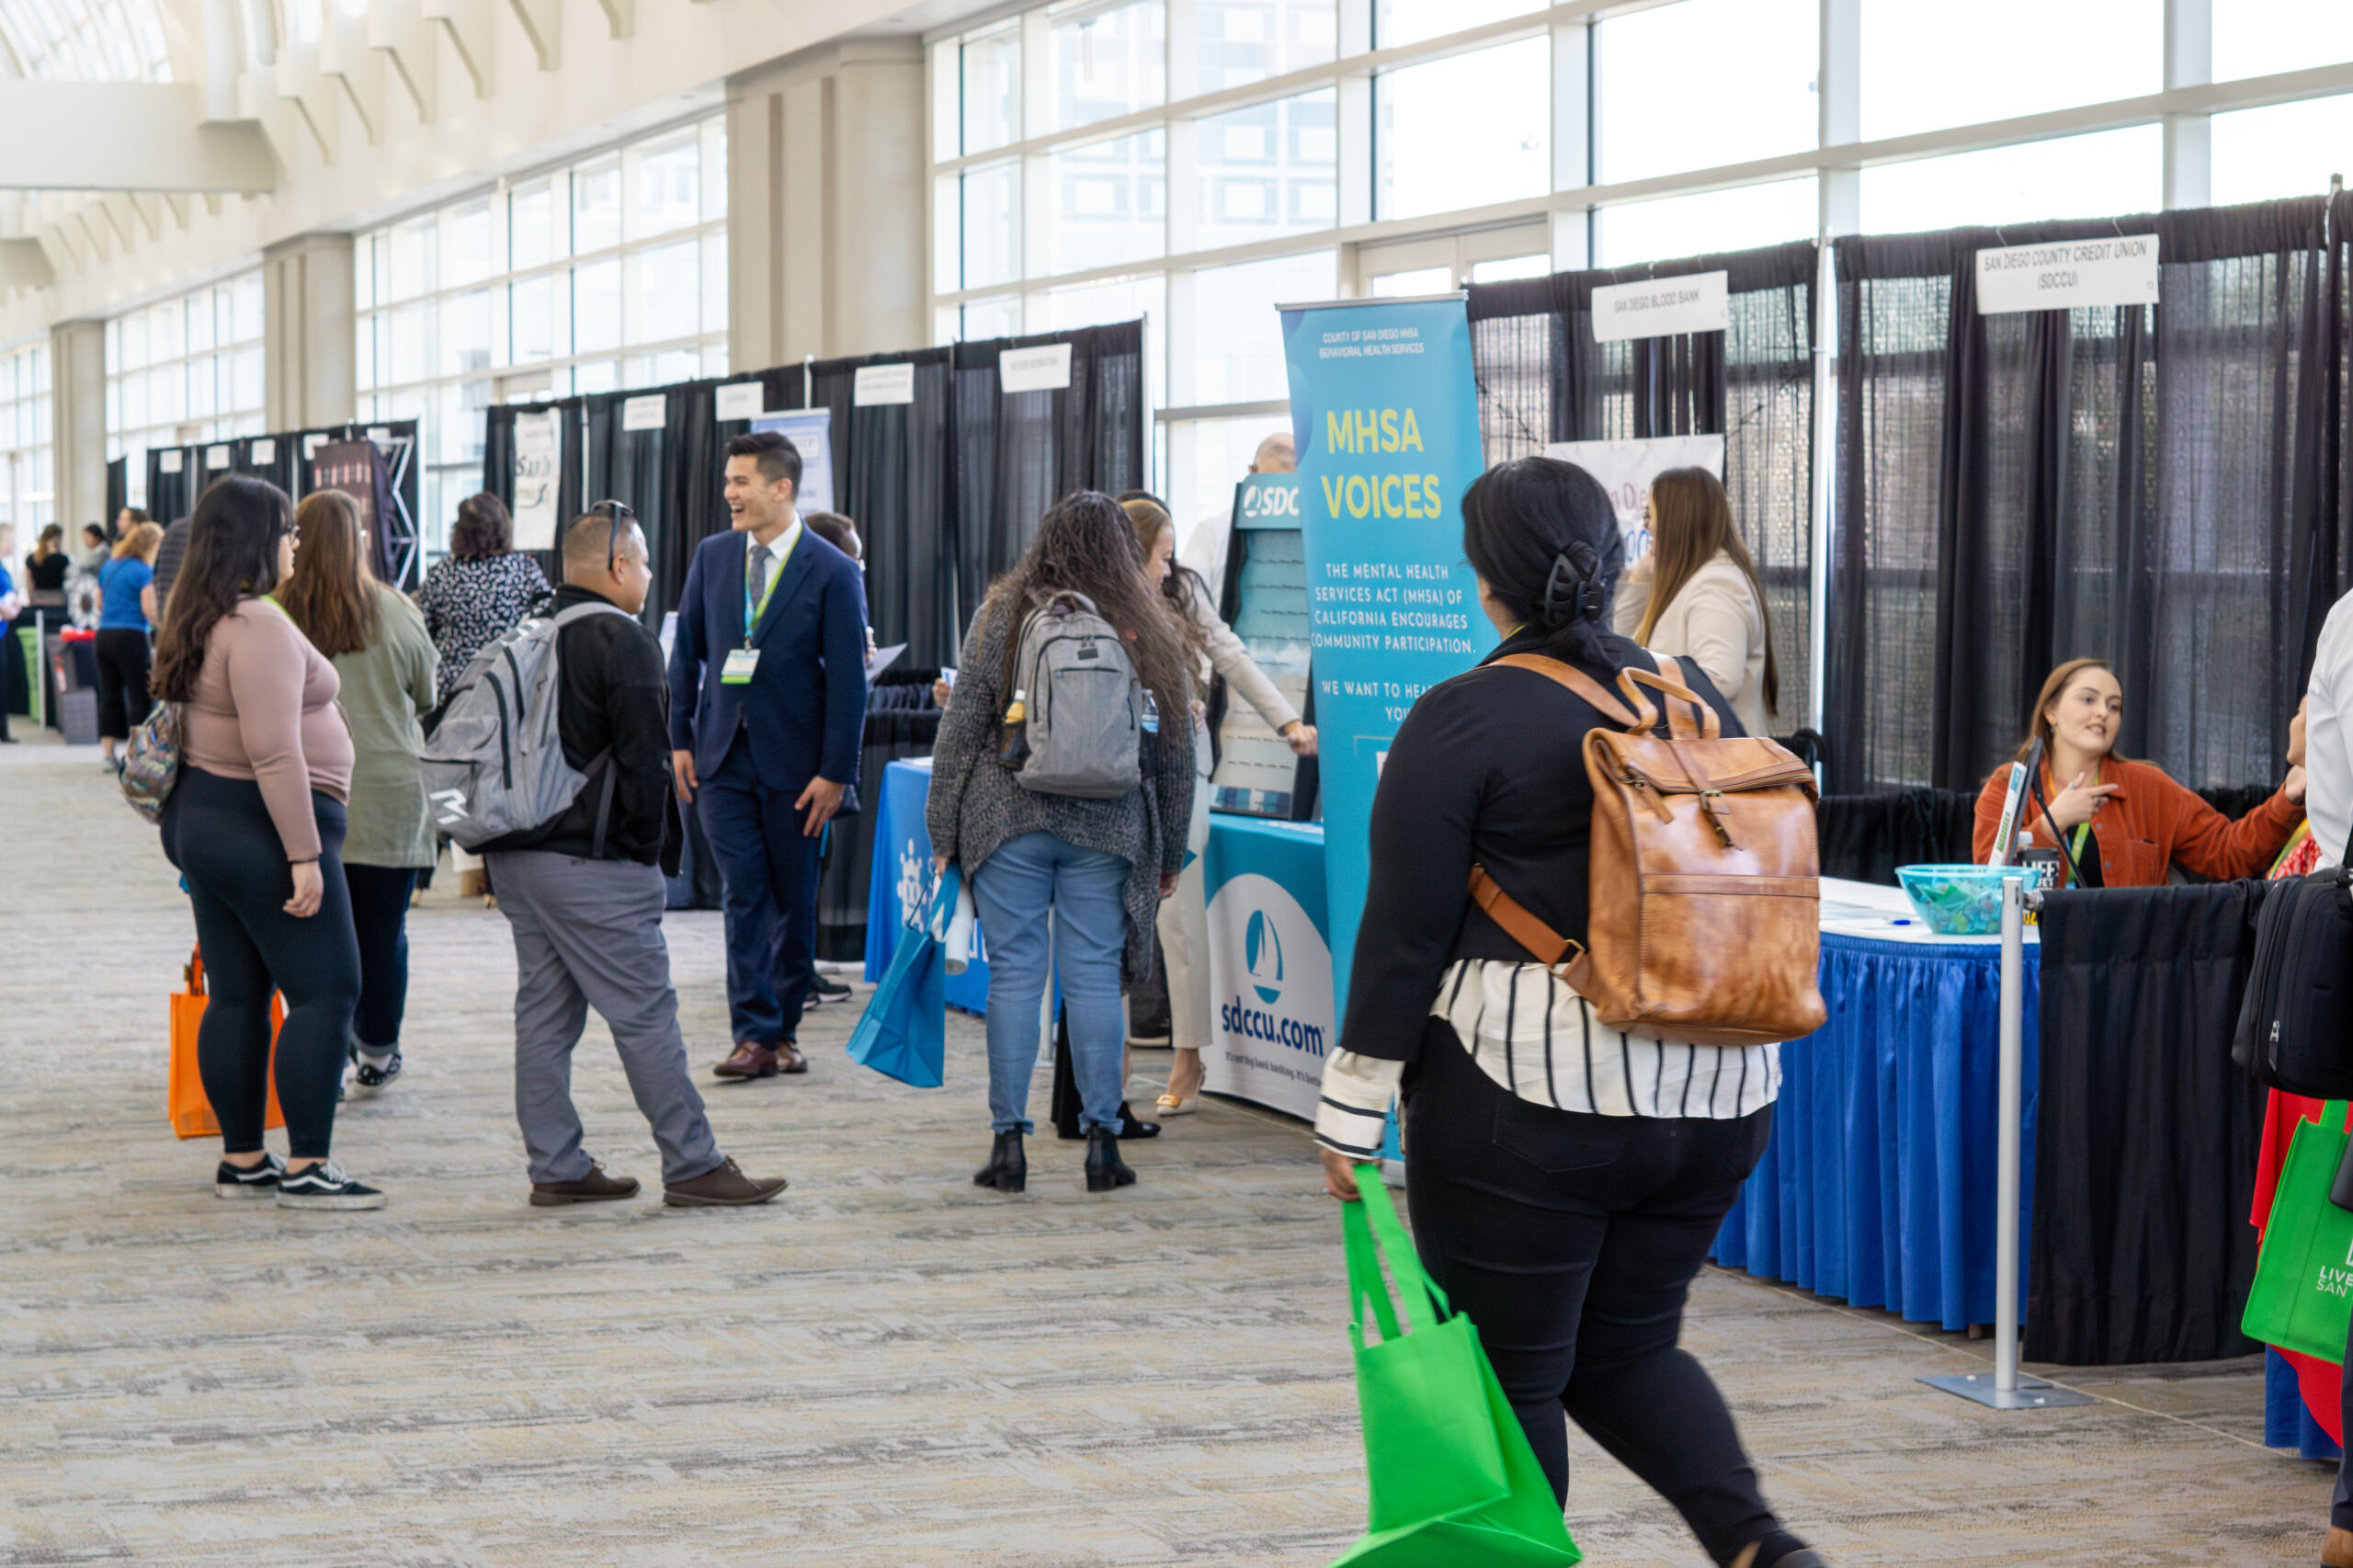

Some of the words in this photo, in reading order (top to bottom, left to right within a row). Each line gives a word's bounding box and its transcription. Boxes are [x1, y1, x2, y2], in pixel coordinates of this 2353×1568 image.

[1984, 256, 2002, 272] SAN
[2004, 251, 2030, 269] DIEGO
[2032, 248, 2071, 266] COUNTY
[2074, 244, 2111, 262] CREDIT
[2114, 240, 2147, 259] UNION
[2037, 270, 2078, 290] (SDCCU)
[1614, 300, 1627, 313] SAN
[1629, 296, 1649, 311] DIEGO
[1651, 291, 1677, 309] BLOOD
[1678, 289, 1699, 304] BANK
[1323, 331, 1350, 344] COUNTY
[1351, 331, 1361, 342] OF
[1362, 329, 1377, 341] SAN
[1378, 328, 1399, 340] DIEGO
[1319, 345, 1362, 359] BEHAVIORAL
[1363, 344, 1391, 357] HEALTH
[1392, 342, 1424, 355] SERVICES
[1326, 407, 1424, 455] MHSA
[1261, 486, 1300, 517] SDC
[1321, 473, 1442, 519] VOICES
[1325, 563, 1348, 578] THE
[1353, 563, 1402, 579] MENTAL
[1406, 564, 1449, 580] HEALTH
[1315, 586, 1371, 602] SERVICES
[1376, 587, 1397, 603] ACT
[1404, 588, 1443, 607] (MHSA)
[1447, 589, 1462, 605] OF
[1314, 610, 1387, 626] CALIFORNIA
[1392, 611, 1468, 630] ENCOURAGES
[1311, 633, 1380, 649] COMMUNITY
[1385, 635, 1476, 654] PARTICIPATION.
[1322, 680, 1339, 696] WE
[1344, 681, 1379, 697] WANT
[1383, 682, 1400, 698] TO
[1405, 683, 1433, 699] HEA
[1222, 995, 1324, 1057] sdccu.com
[2320, 1266, 2353, 1287] LIVE
[2316, 1278, 2347, 1298] SAN
